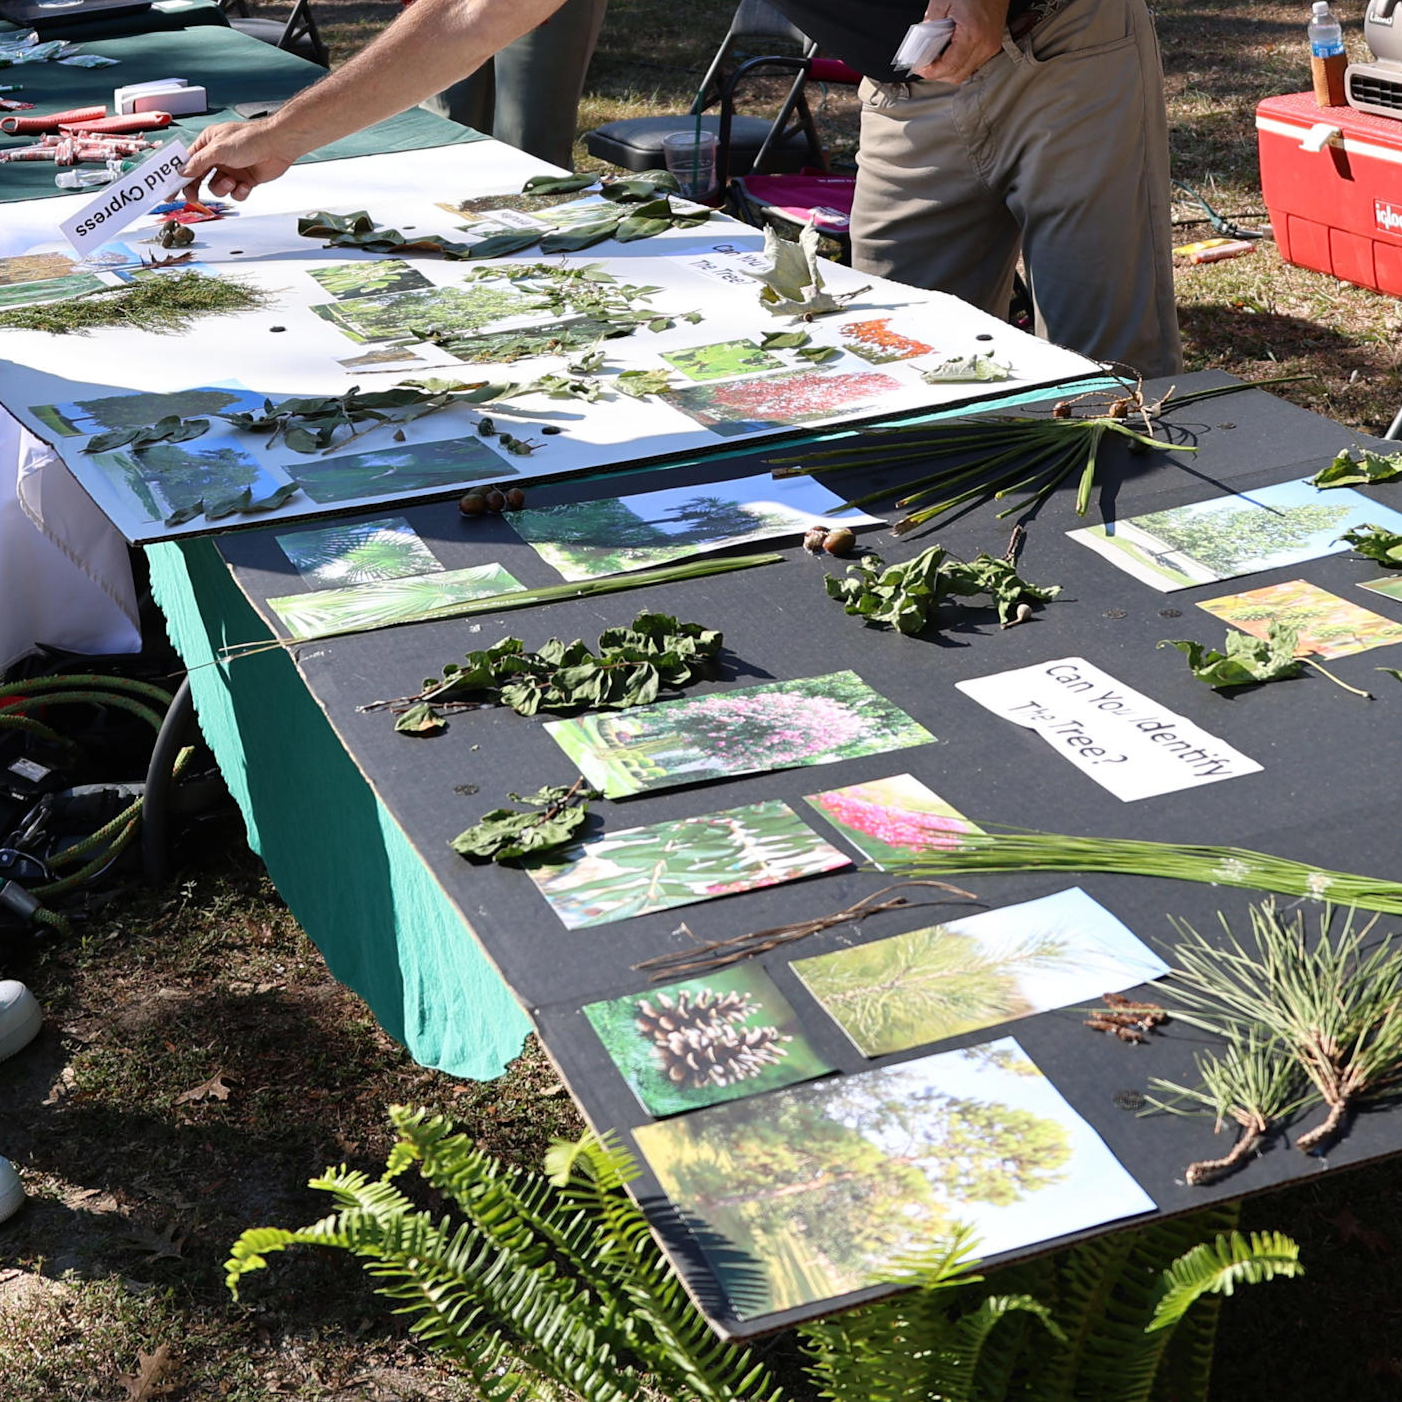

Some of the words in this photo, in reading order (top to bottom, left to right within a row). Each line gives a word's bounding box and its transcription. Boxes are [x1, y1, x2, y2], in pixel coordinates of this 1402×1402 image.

[144, 155, 184, 190] Bald
[75, 186, 144, 236] Cypress
[1008, 700, 1056, 721] The
[1049, 719, 1129, 765] Tree?
[1046, 665, 1094, 694] Can
[1089, 690, 1131, 716] You
[1128, 716, 1233, 777] Identify
